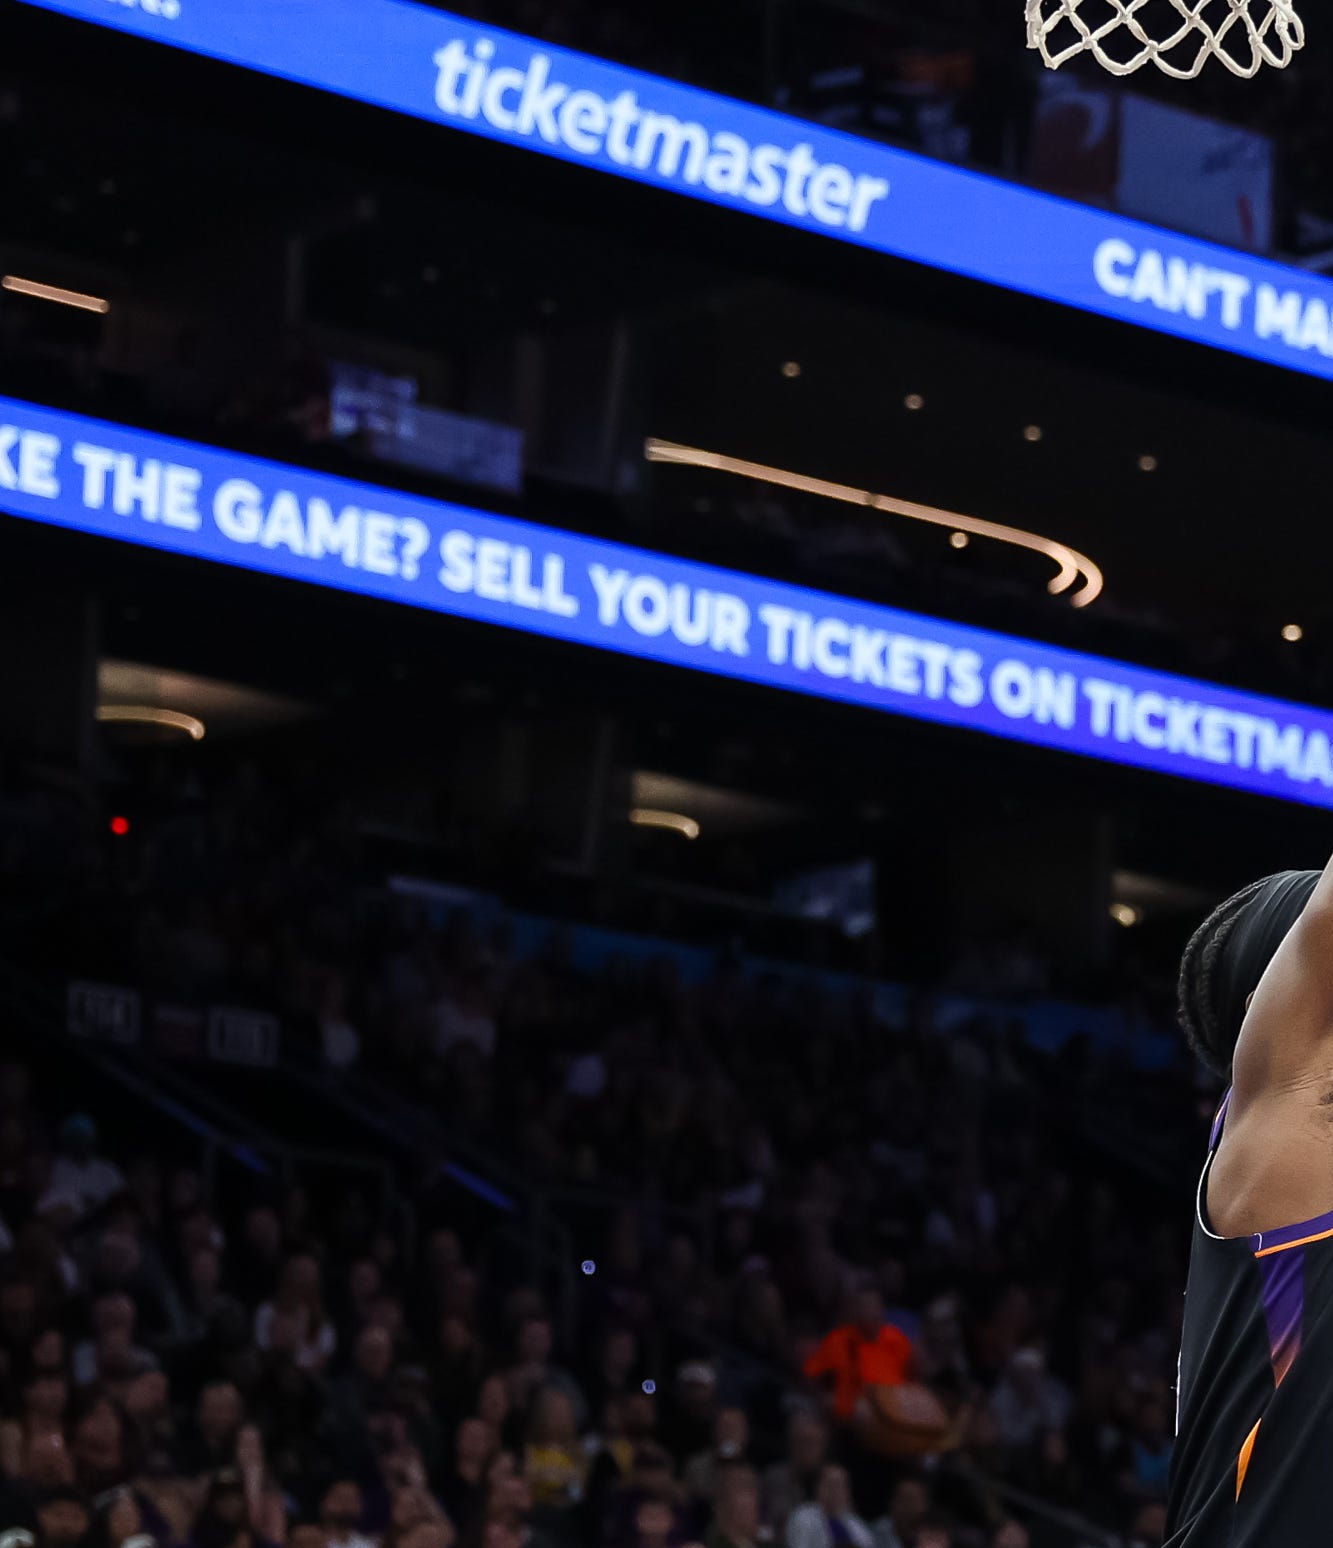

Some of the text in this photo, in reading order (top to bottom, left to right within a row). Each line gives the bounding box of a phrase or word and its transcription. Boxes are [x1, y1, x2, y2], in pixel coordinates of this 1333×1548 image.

[434, 39, 888, 231] ticketmaster
[1093, 238, 1248, 328] CAN'T
[72, 441, 200, 530] THE
[212, 478, 430, 581] GAME?
[439, 530, 579, 618] SELL
[587, 563, 751, 656] YOUR
[758, 604, 984, 707] TICKETS
[990, 660, 1076, 727] ON
